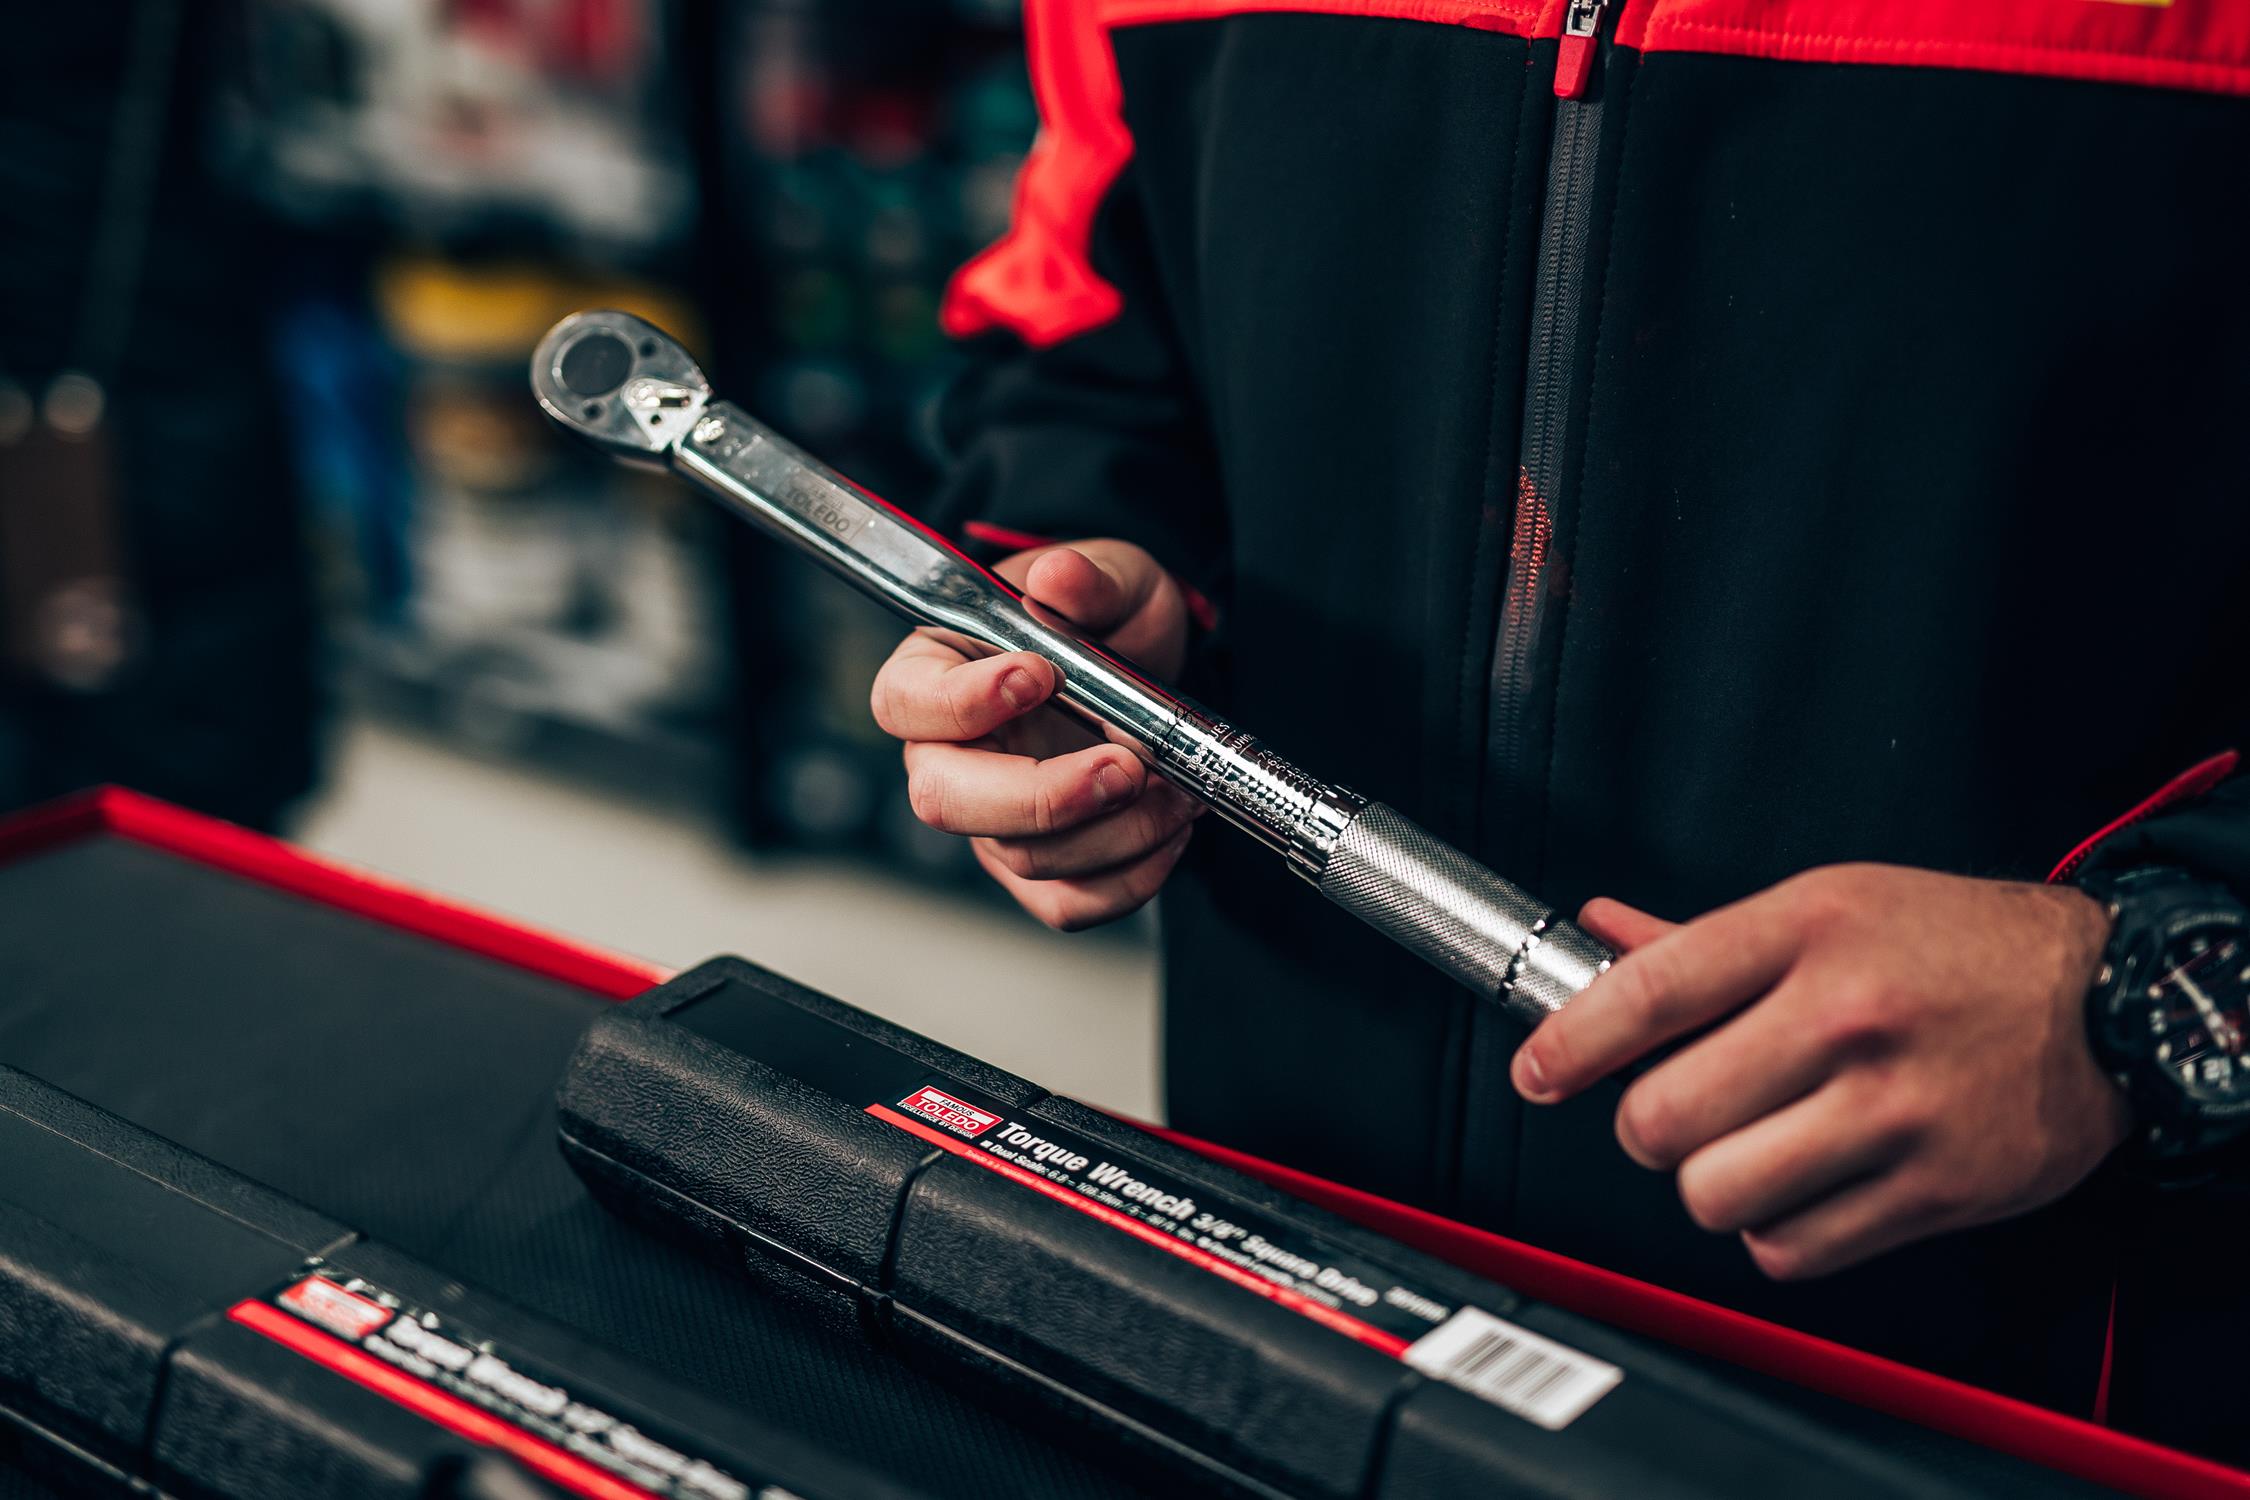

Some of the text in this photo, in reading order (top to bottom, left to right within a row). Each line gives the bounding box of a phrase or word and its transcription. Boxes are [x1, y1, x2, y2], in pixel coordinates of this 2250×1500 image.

[786, 486, 850, 532] TOLEDO
[896, 1101, 939, 1123] EXCELLENCE
[948, 1124, 976, 1140] DESIGN
[914, 1097, 980, 1130] TOLEDO
[940, 1099, 975, 1117] FAMOUS
[988, 1143, 1019, 1161] Dual
[996, 1121, 1089, 1171] Torque
[1087, 1161, 1197, 1221] Wrench
[1239, 1234, 1320, 1280] Square
